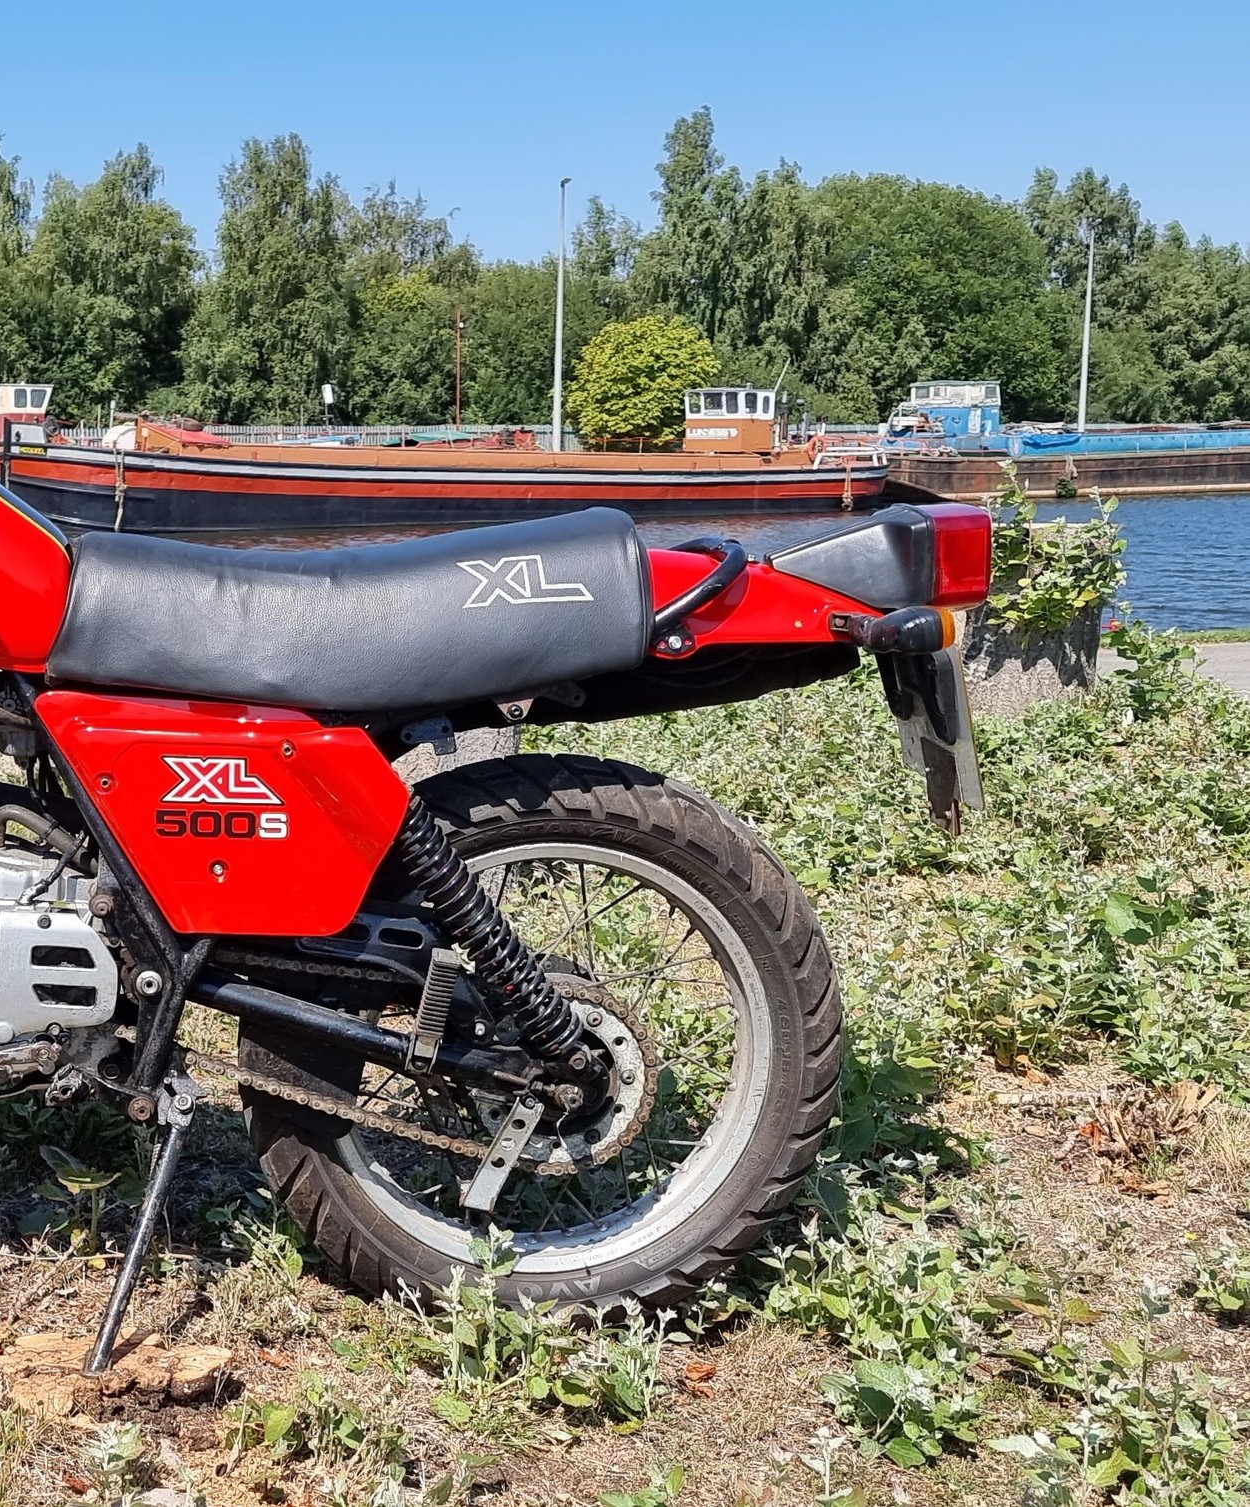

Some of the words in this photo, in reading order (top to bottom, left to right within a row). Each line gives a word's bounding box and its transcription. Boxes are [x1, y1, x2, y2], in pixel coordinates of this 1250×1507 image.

[456, 555, 595, 608] XL
[159, 755, 285, 806] XL
[154, 809, 288, 839] 500S
